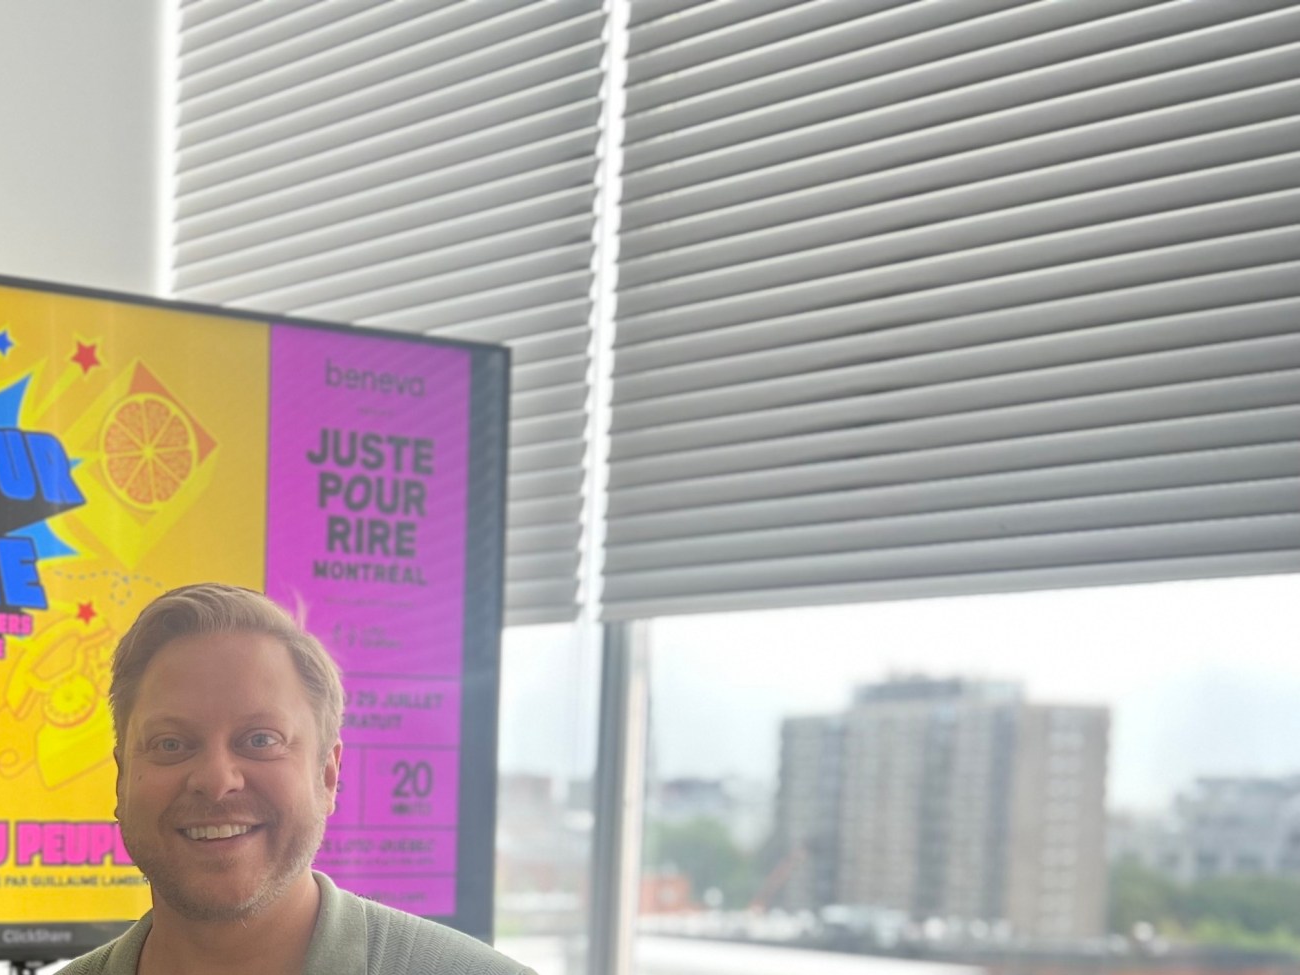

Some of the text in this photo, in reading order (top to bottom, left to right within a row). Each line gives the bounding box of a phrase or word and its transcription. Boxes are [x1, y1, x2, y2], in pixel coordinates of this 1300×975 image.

[325, 359, 428, 398] beneva
[306, 427, 435, 476] JUSTE
[318, 472, 427, 517] POUR
[326, 515, 417, 558] RIRE
[391, 760, 434, 799] 20
[2, 929, 73, 943] ClickShare
